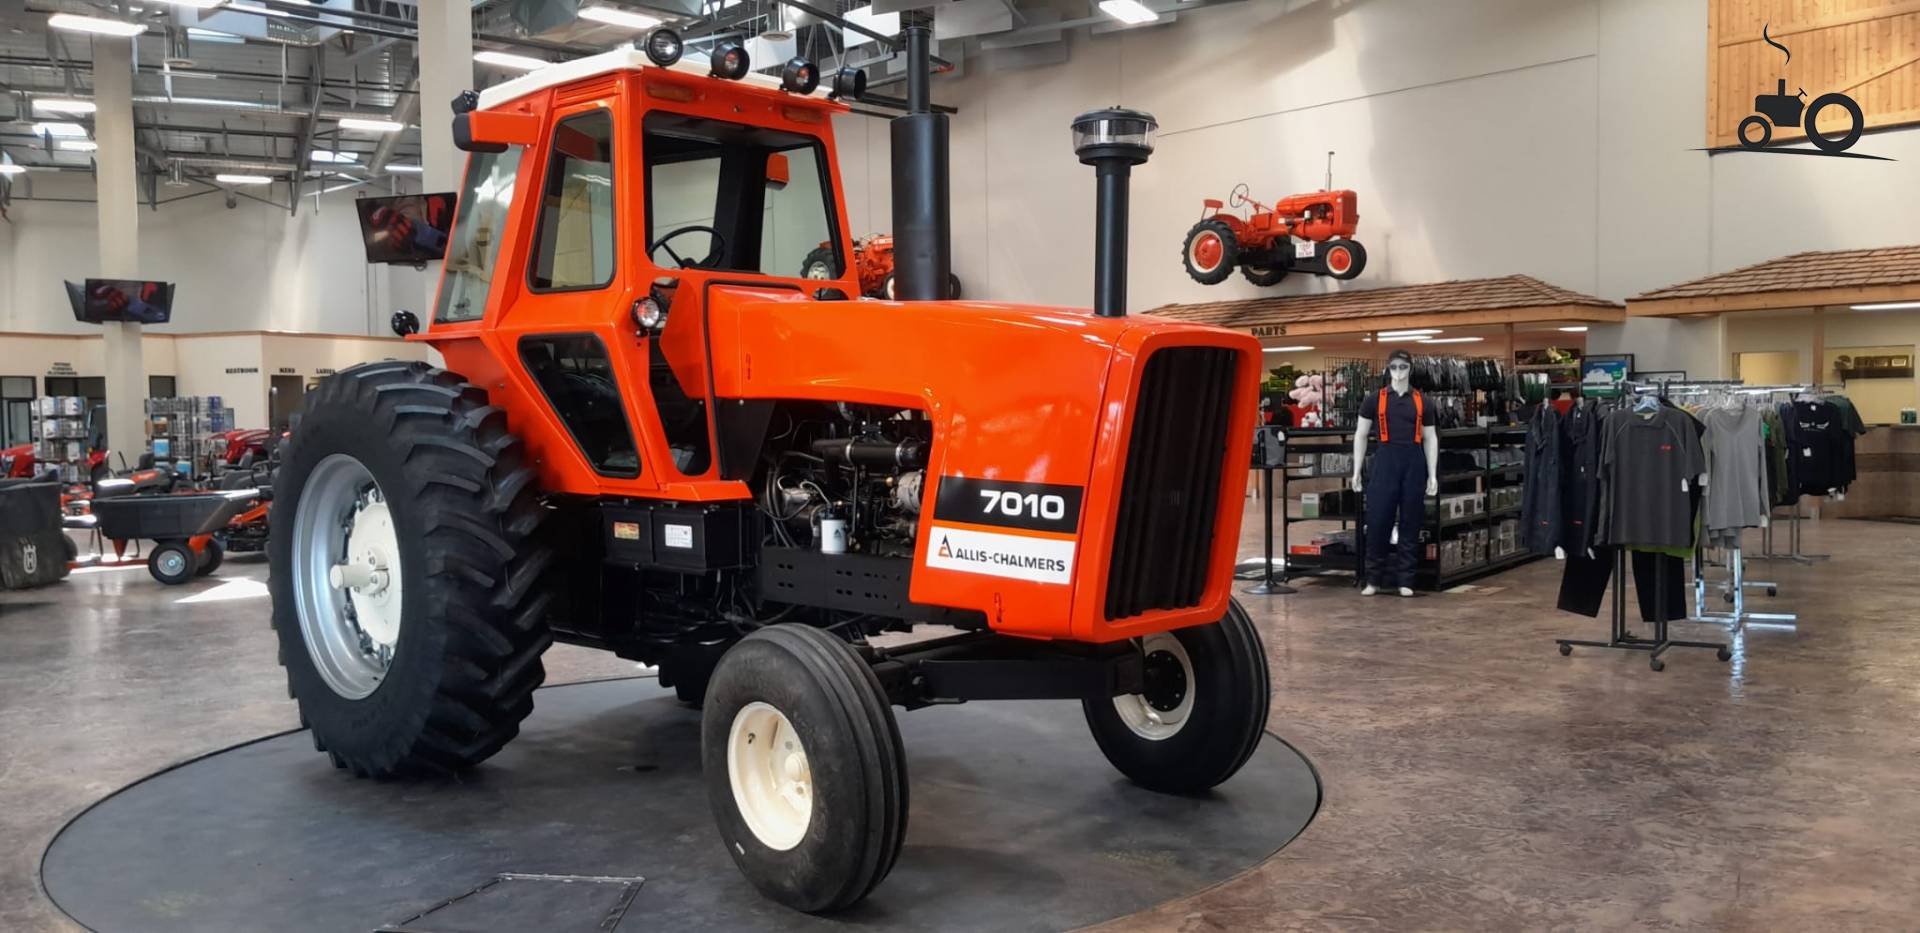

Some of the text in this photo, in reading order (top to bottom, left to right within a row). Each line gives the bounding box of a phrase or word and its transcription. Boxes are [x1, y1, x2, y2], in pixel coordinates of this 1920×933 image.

[1251, 326, 1286, 336] PARTS
[980, 490, 1064, 519] 7010
[955, 548, 1065, 571] ALLIS-CHALMERS
